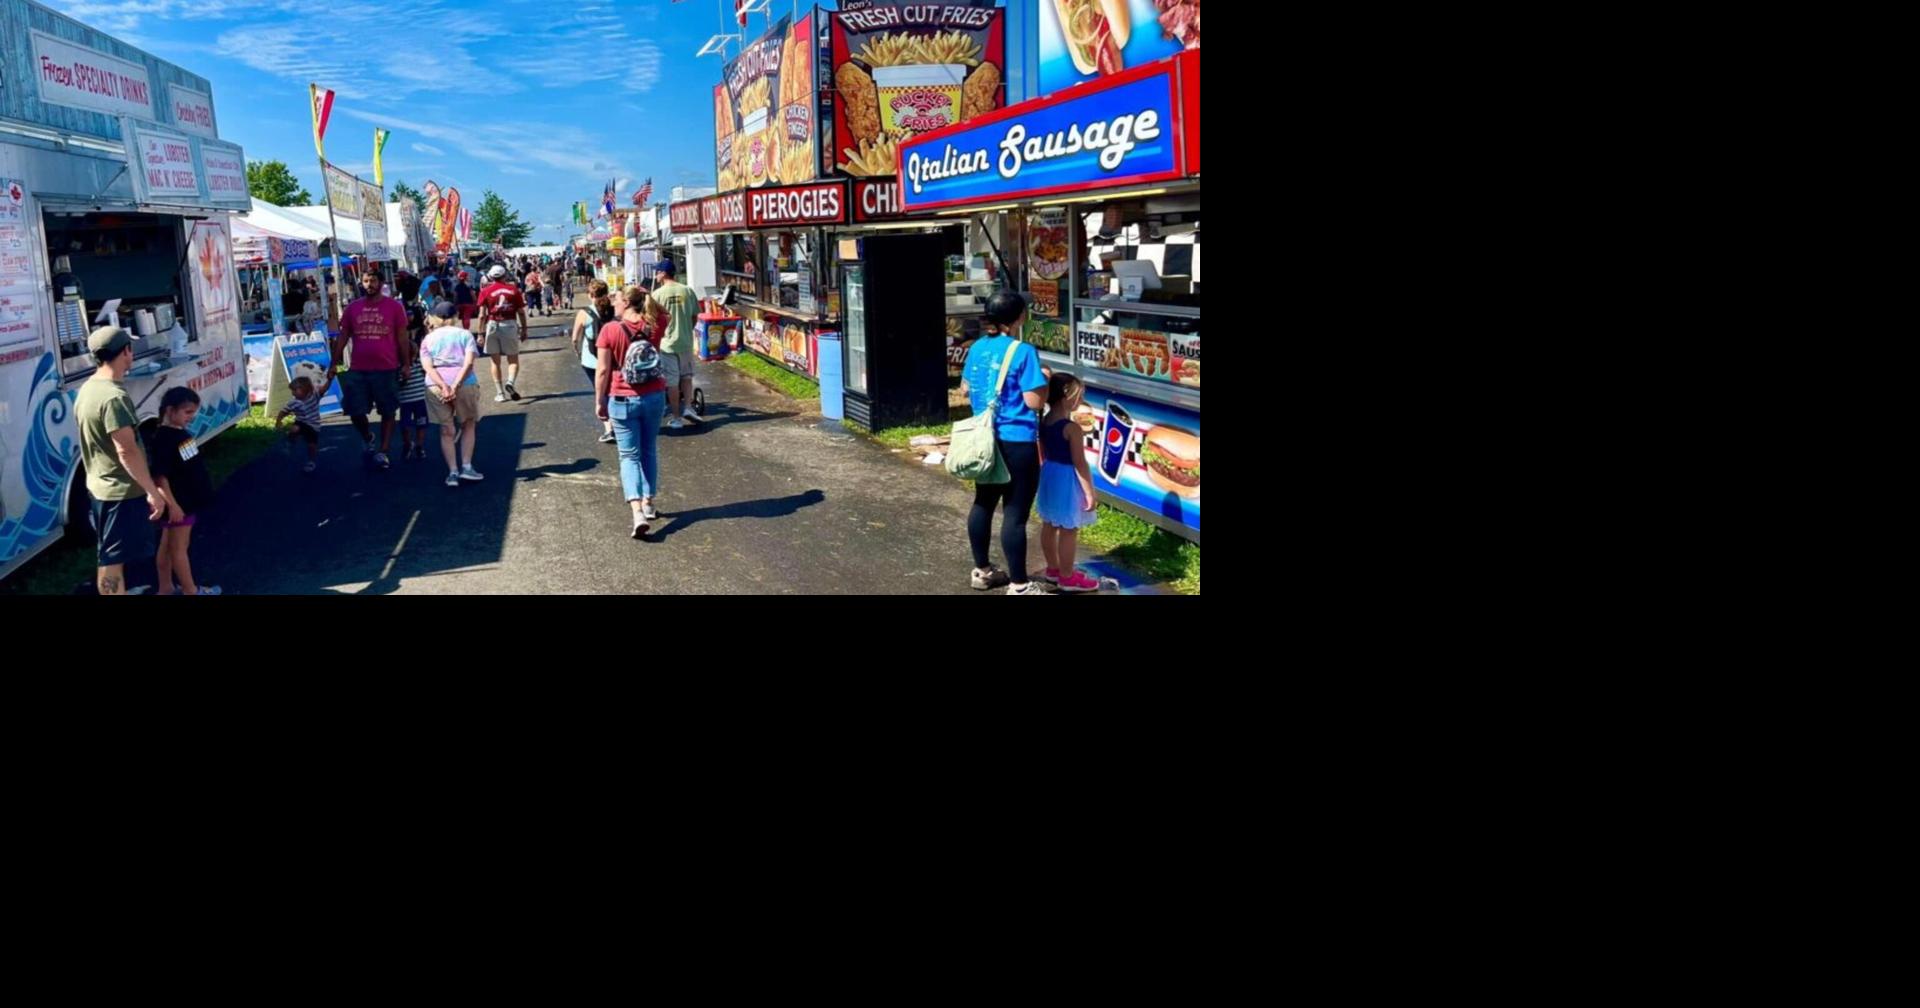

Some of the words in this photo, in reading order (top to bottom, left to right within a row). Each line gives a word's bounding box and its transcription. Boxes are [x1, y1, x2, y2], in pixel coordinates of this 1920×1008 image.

[841, 0, 872, 11] Leon's
[839, 7, 900, 30] FRESH
[903, 5, 939, 23] CUT
[941, 6, 995, 26] FRIES
[41, 56, 74, 87] Frozen
[74, 62, 120, 98] SPECIALTY
[119, 75, 149, 106] DRINKS
[786, 104, 809, 120] CHICKEN
[902, 115, 946, 133] FRIES
[163, 143, 190, 163] LOBSTER
[908, 143, 990, 193] Italian
[999, 109, 1160, 178] Sausage
[147, 168, 164, 188] MAC
[172, 170, 196, 189] CHEESE
[752, 187, 839, 220] PIEROGIES
[863, 183, 898, 214] CHI
[702, 200, 721, 225] CORN
[721, 194, 743, 223] DOGS
[1078, 331, 1116, 349] FRENCH
[1172, 340, 1200, 360] SAUS
[1079, 346, 1106, 363] FRIES
